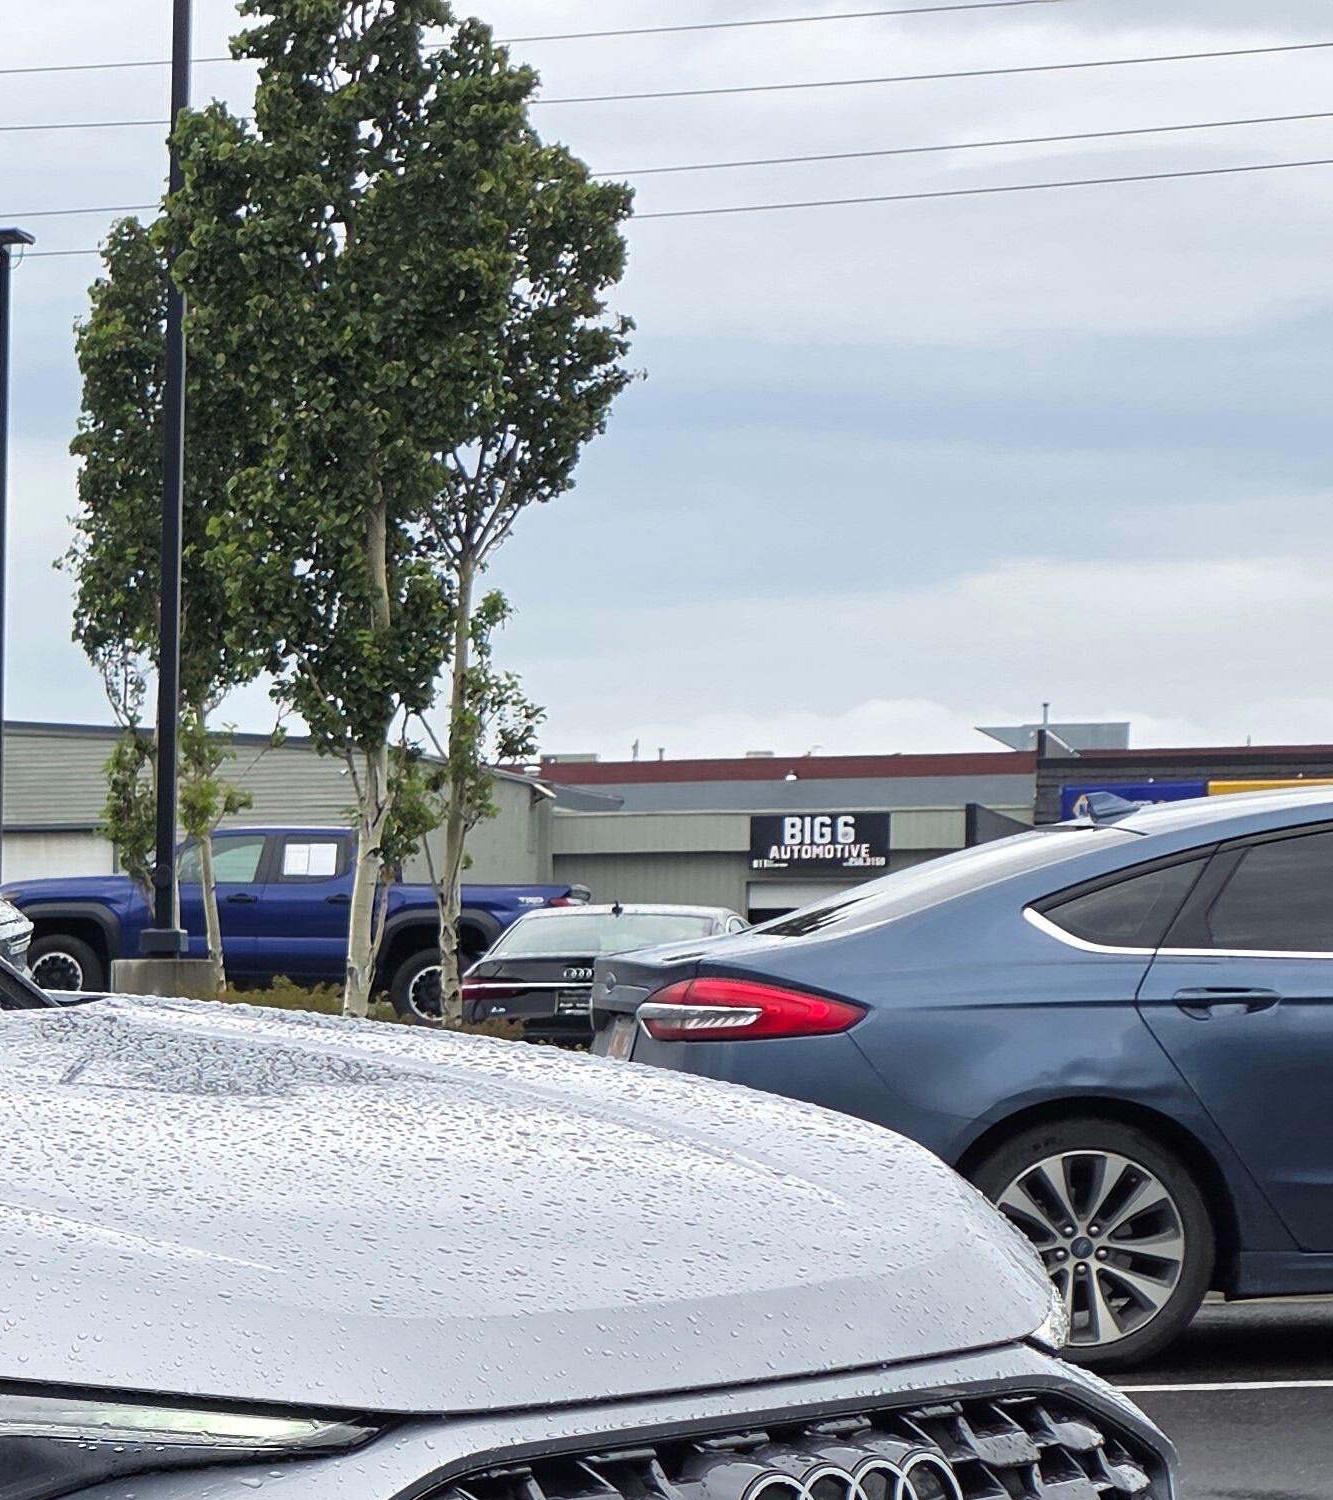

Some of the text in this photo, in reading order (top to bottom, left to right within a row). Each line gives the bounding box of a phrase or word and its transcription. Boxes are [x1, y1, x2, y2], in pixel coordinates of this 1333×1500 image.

[784, 815, 856, 845] BIG 6
[769, 844, 870, 859] AUTOMOTIVE
